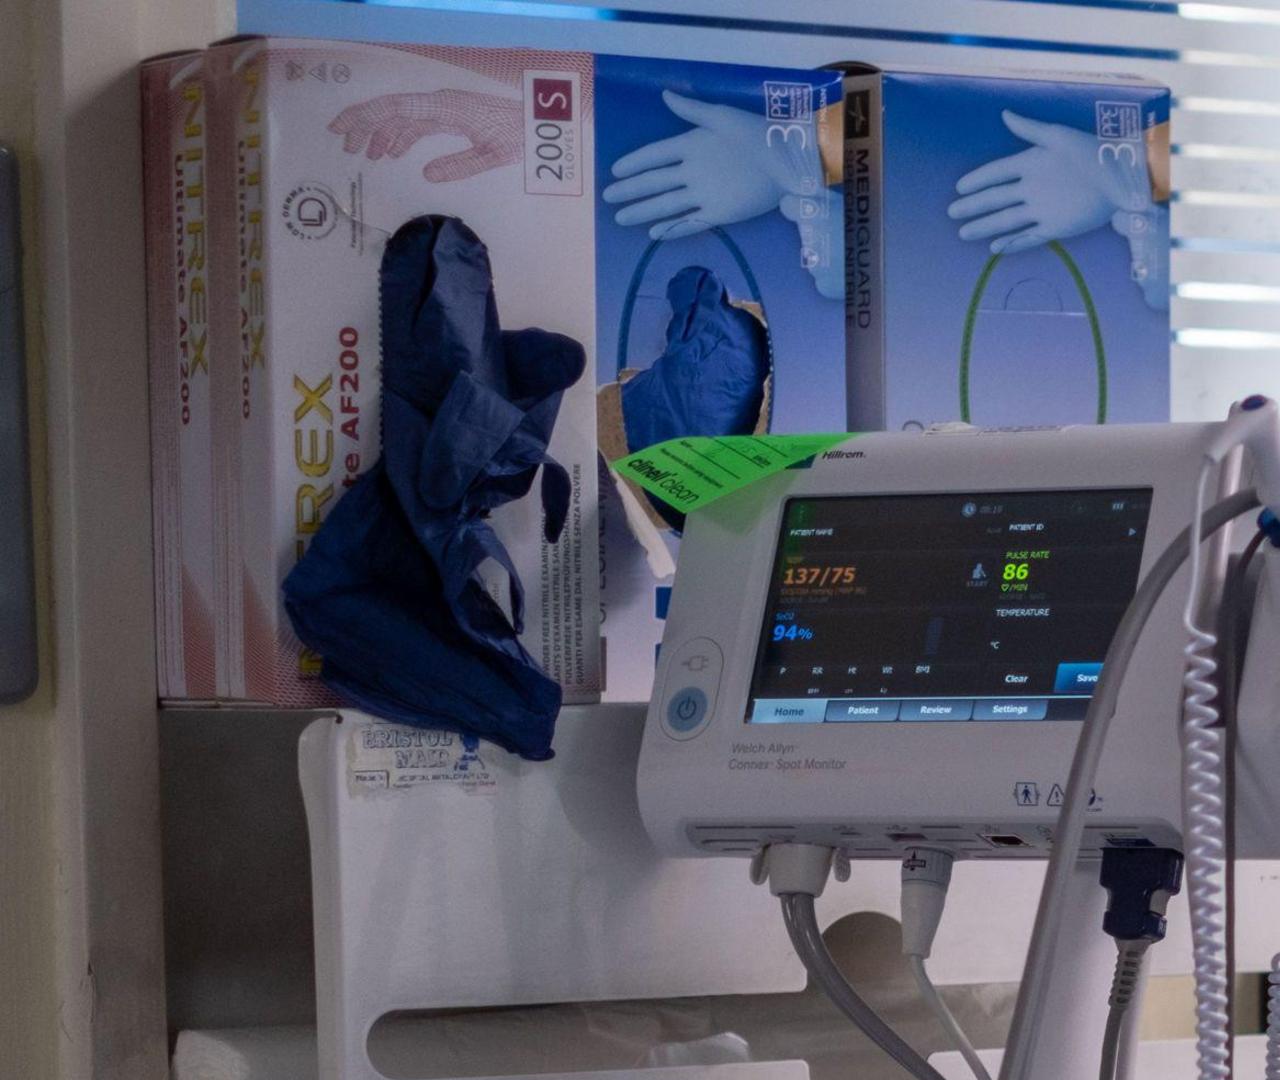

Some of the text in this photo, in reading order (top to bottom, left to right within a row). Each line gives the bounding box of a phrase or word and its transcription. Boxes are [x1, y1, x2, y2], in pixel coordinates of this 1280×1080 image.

[536, 91, 566, 181] 200 S
[565, 128, 575, 180] GLOVES
[845, 149, 855, 328] SPECIAL NITRILE
[856, 149, 871, 330] MEDIGUARD
[339, 327, 360, 441] AF200
[573, 464, 581, 504] POLVERE
[627, 458, 669, 483] clinell
[659, 476, 701, 505] clean
[573, 506, 581, 536] SENZA
[552, 545, 560, 563] SAN
[573, 540, 582, 573] NITRILE
[1005, 550, 1050, 559] PULSE RATE
[783, 566, 856, 588] 137/75
[1003, 563, 1029, 580] 86
[541, 584, 550, 618] NITRILE
[574, 597, 583, 627] ESAME
[996, 607, 1050, 617] TEMPERATURE
[541, 621, 550, 643] FREE
[773, 624, 813, 642] 94%
[1005, 673, 1029, 684] Clear
[774, 706, 804, 718] Home
[847, 705, 879, 715] Patient
[920, 705, 952, 715] Review
[992, 704, 1028, 717] Settings
[361, 729, 453, 749] BRISTOL
[731, 743, 796, 757] Welch Allyn
[776, 758, 801, 772] Spot
[803, 758, 847, 770] Monitor
